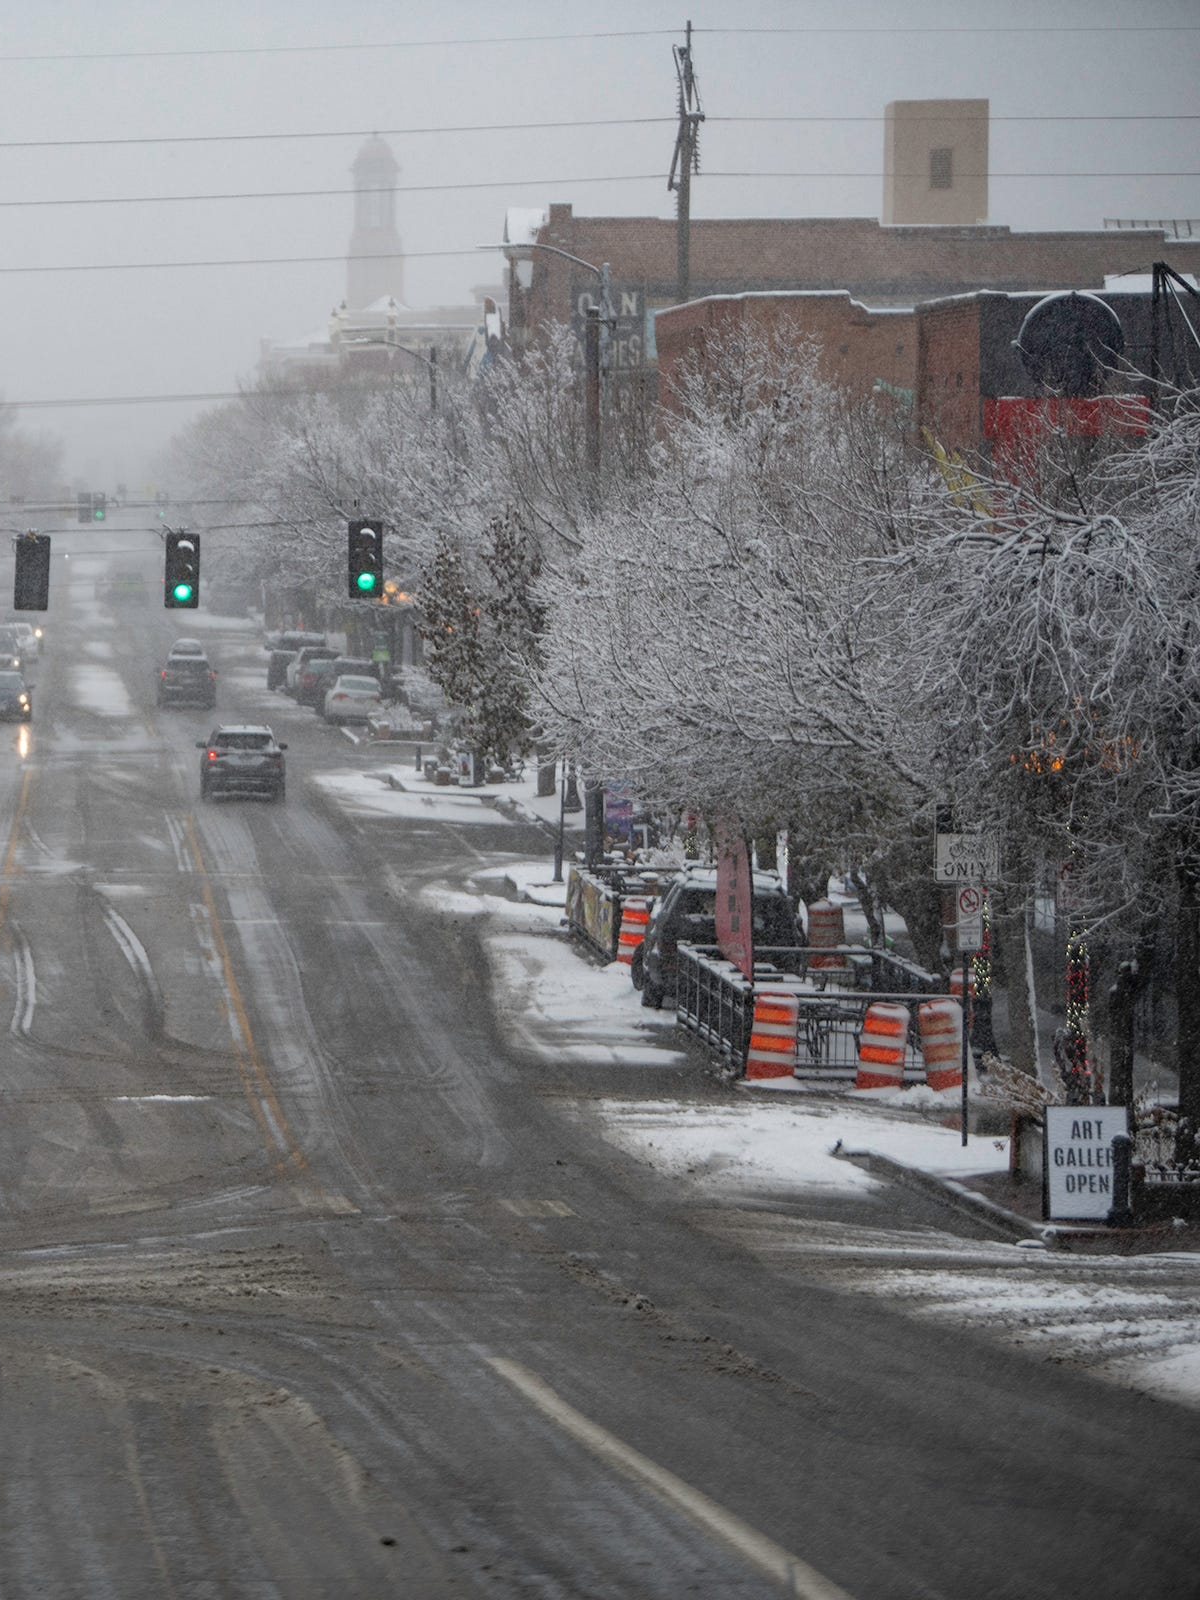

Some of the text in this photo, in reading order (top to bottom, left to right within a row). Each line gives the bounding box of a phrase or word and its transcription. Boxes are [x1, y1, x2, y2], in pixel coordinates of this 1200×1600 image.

[943, 862, 988, 877] ONLY
[1071, 1120, 1103, 1140] ART
[1054, 1147, 1115, 1168] GALLER
[1065, 1174, 1110, 1194] OPEN
